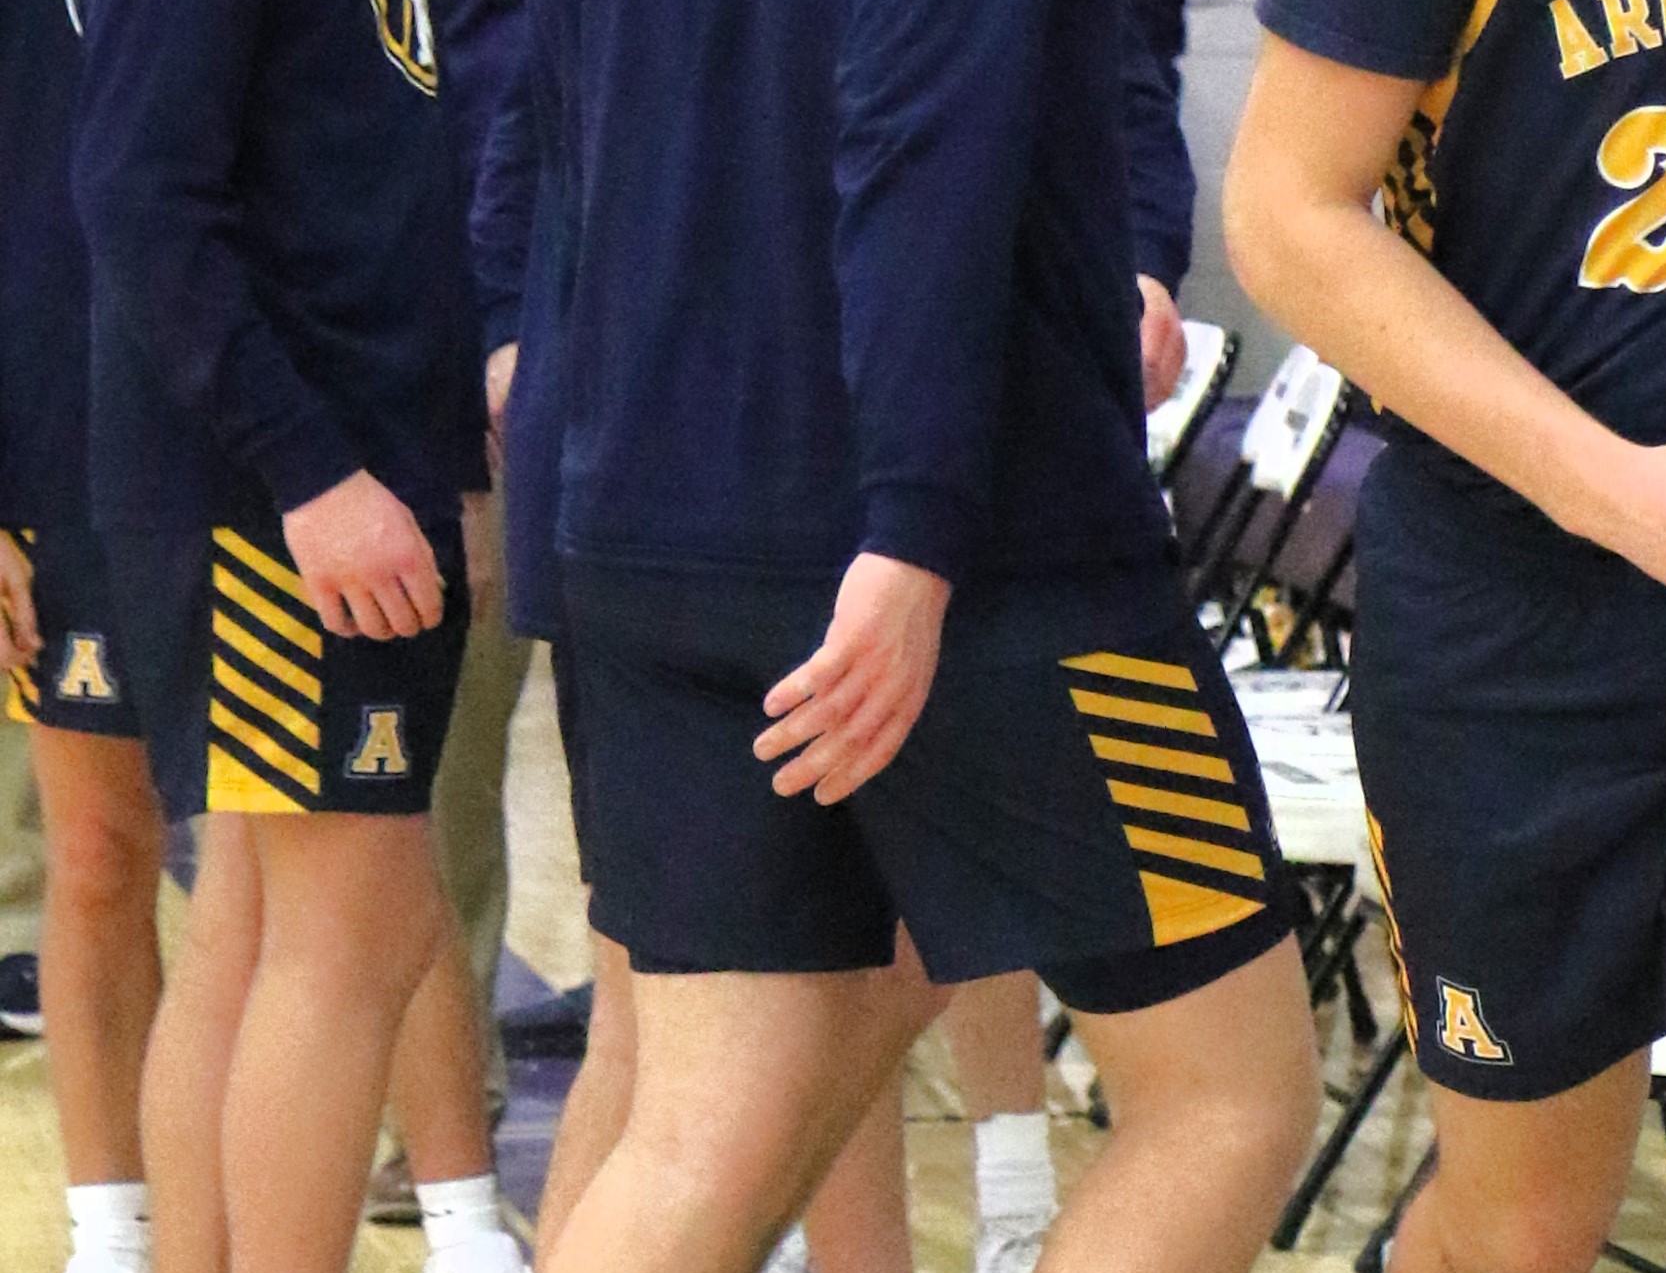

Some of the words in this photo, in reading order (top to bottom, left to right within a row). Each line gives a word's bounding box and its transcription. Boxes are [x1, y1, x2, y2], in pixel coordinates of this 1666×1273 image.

[57, 632, 117, 702] A
[345, 705, 408, 777] A
[1436, 974, 1514, 1065] A
